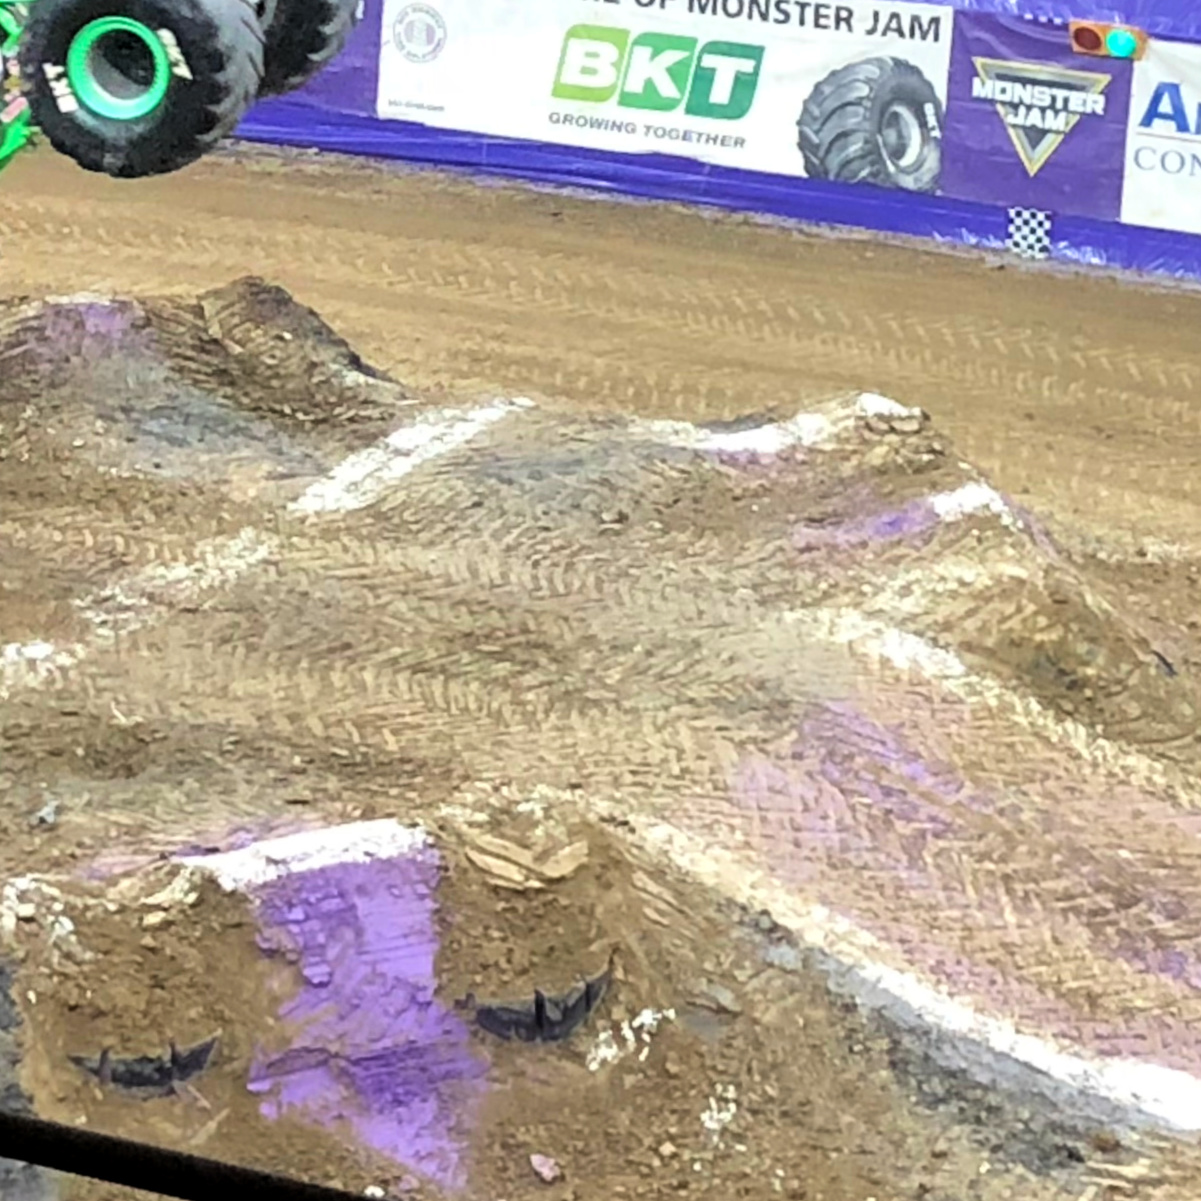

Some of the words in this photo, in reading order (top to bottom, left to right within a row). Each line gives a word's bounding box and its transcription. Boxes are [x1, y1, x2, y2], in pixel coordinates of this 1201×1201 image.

[865, 9, 941, 43] JAM
[559, 37, 757, 106] BKT
[971, 76, 1106, 116] MONSTER
[548, 112, 637, 134] GROWING
[643, 124, 747, 148] TOGETHER
[1006, 104, 1068, 131] JAM
